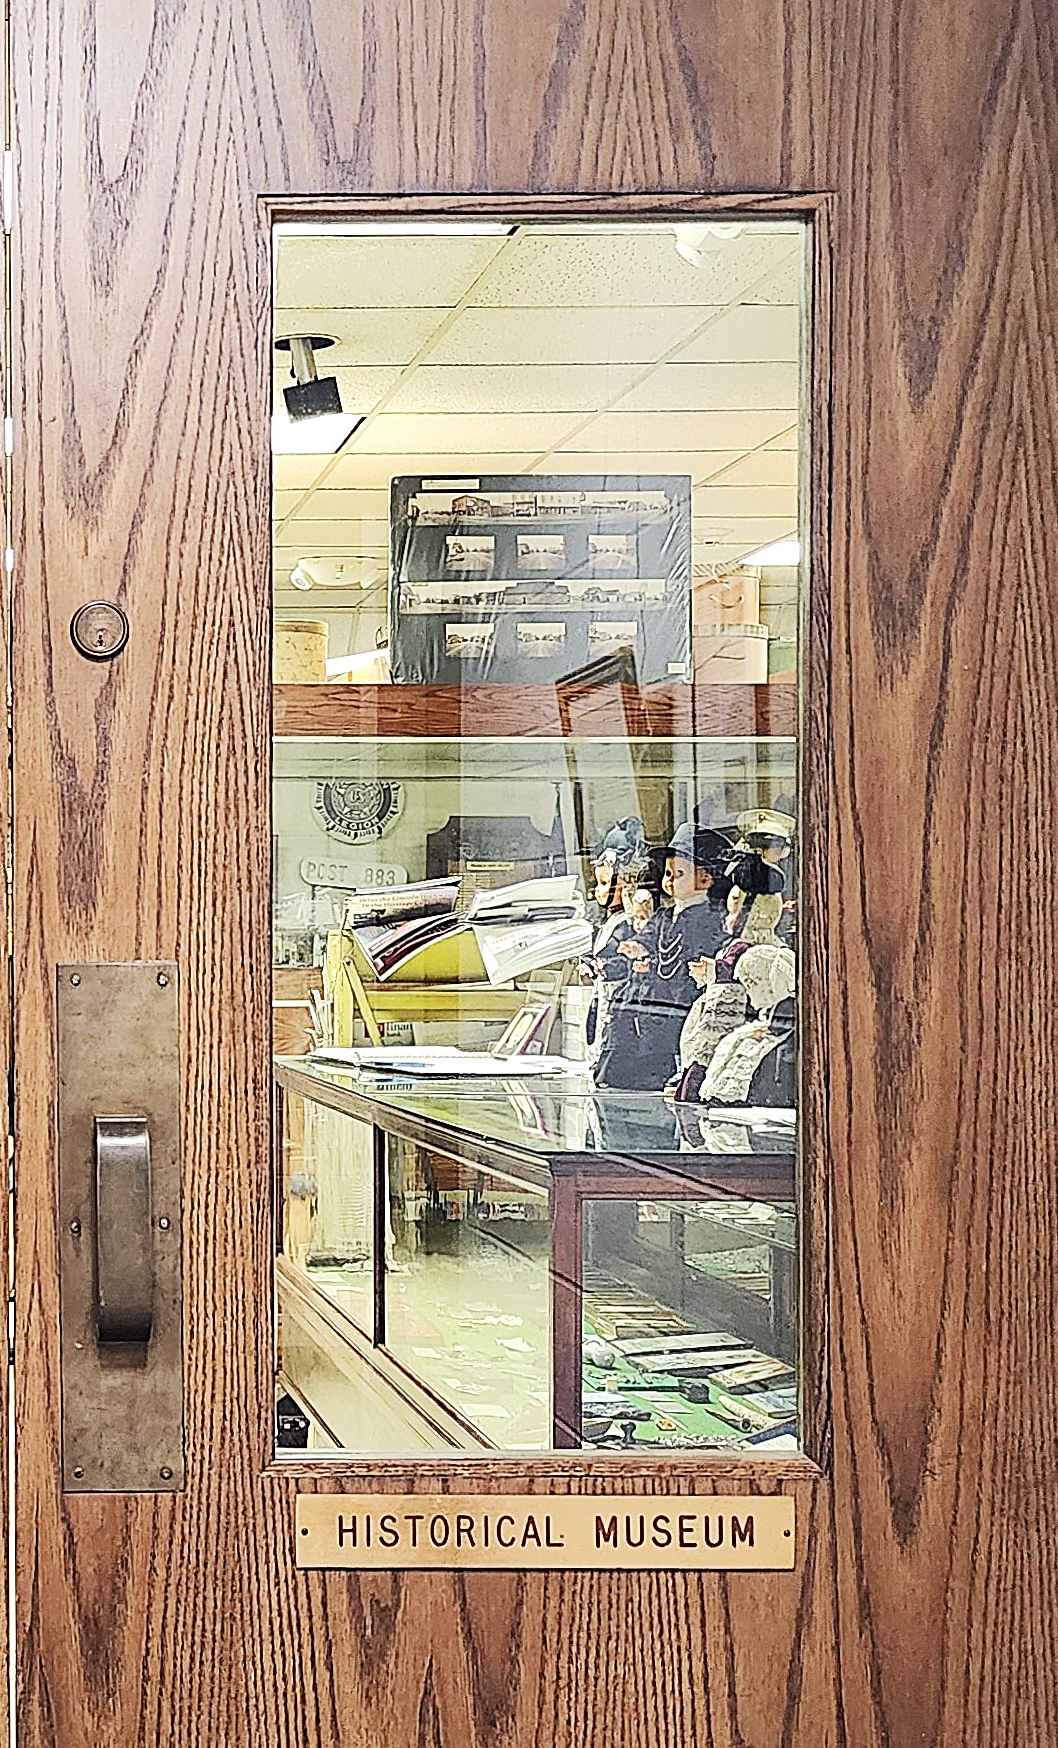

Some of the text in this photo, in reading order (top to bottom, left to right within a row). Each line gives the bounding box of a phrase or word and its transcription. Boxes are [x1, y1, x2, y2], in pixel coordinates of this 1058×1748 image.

[335, 817, 380, 830] LEGION
[306, 861, 395, 886] POST 883
[337, 1514, 755, 1549] HISTORICAL MUSEUM
